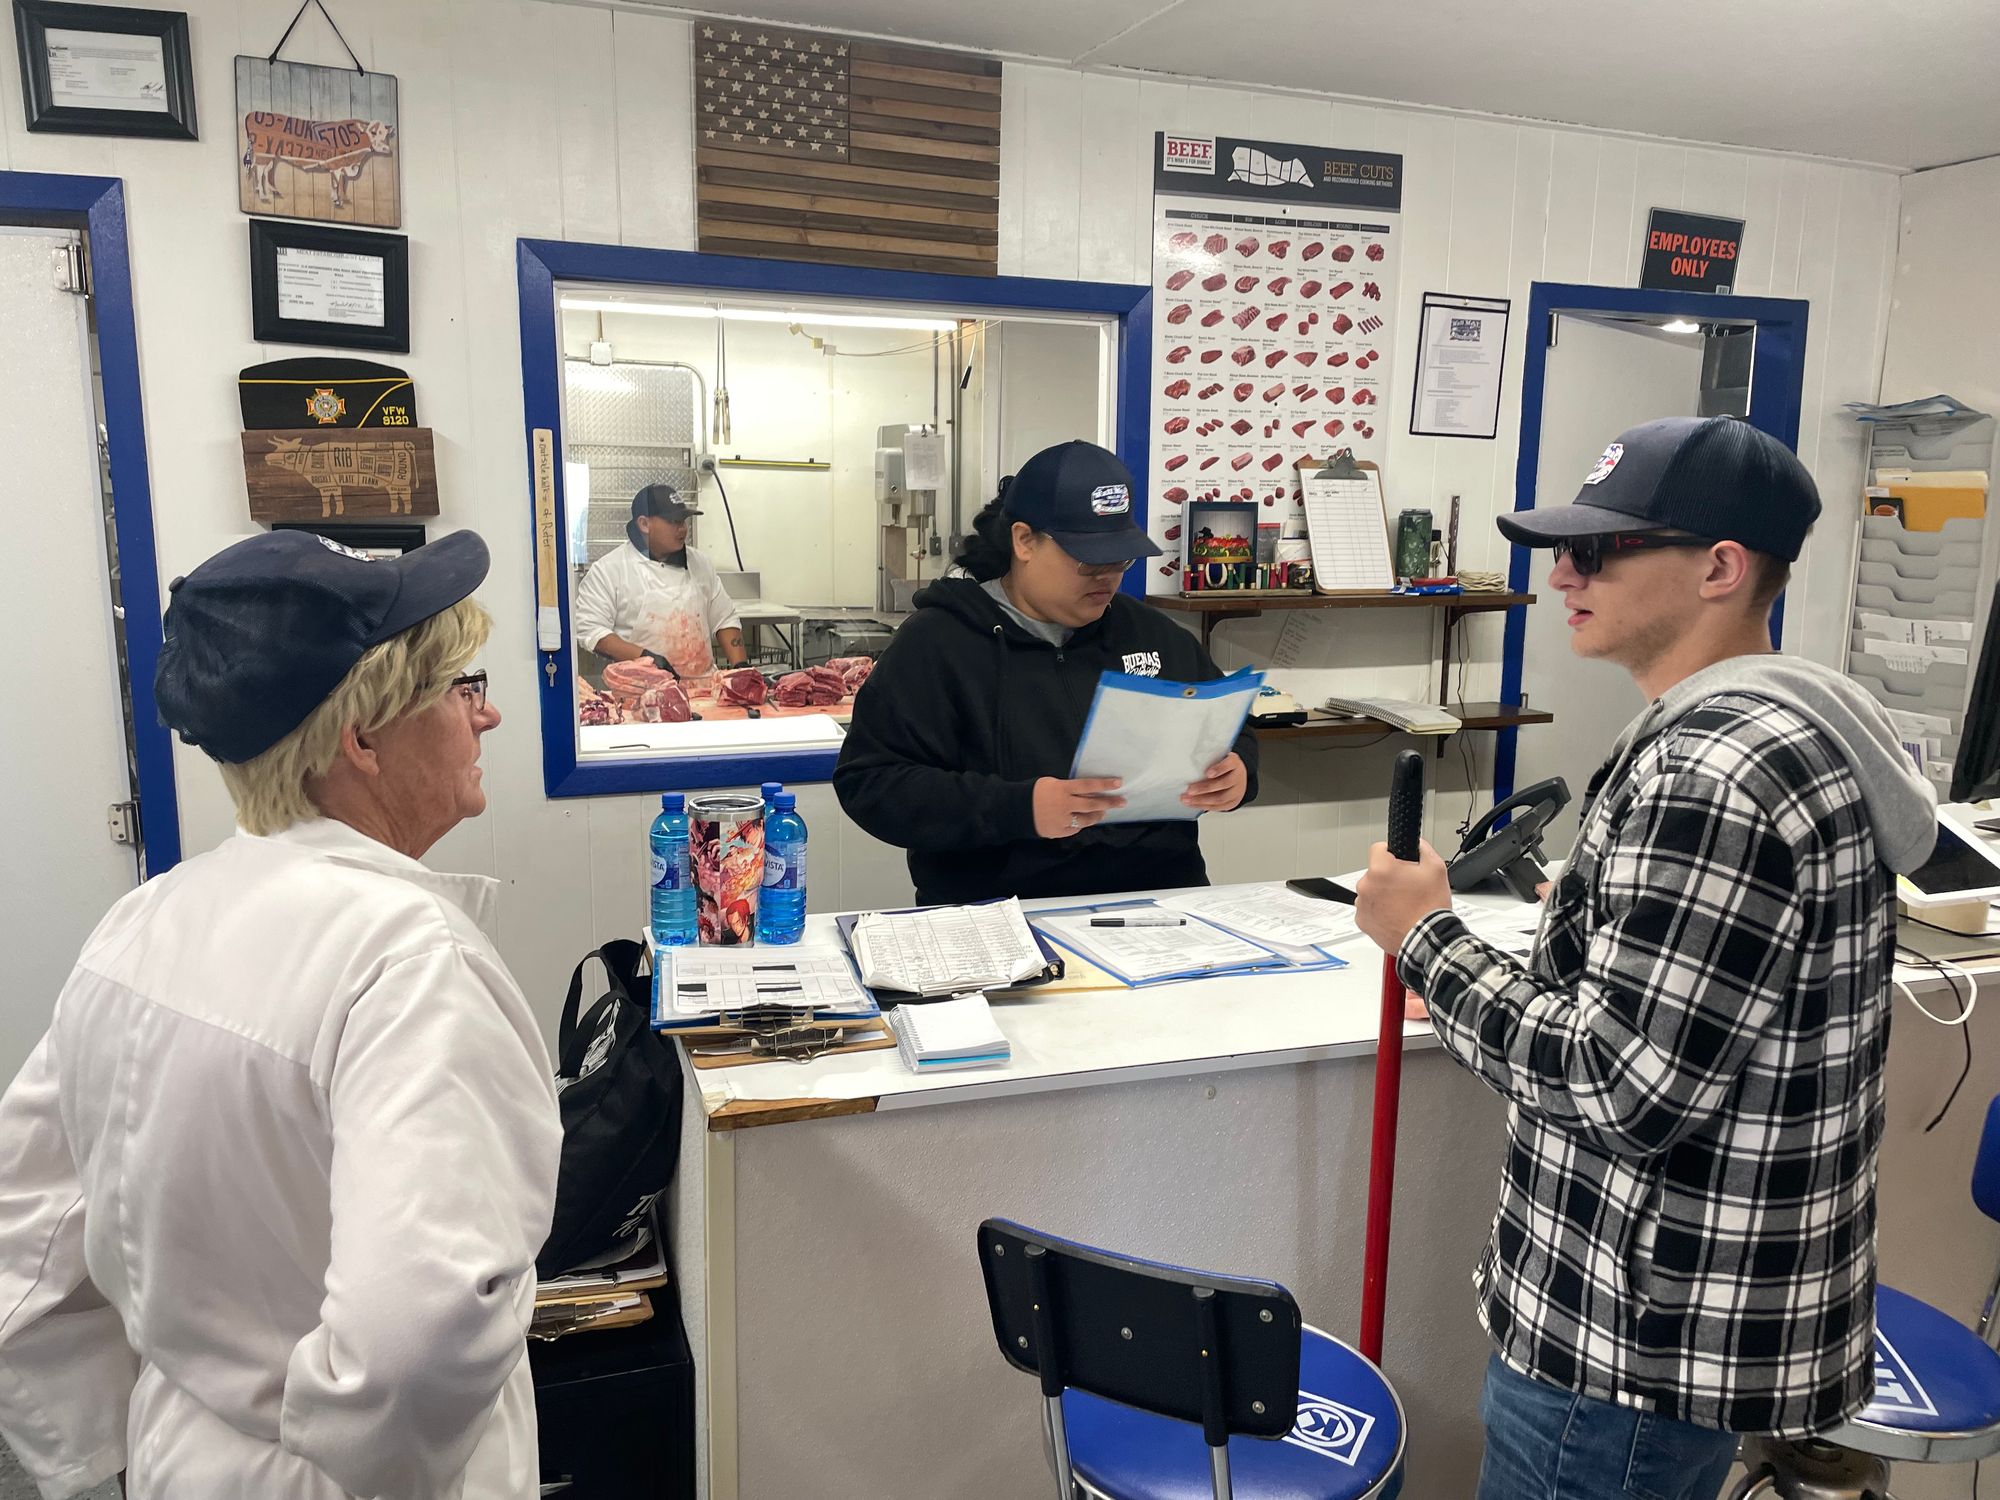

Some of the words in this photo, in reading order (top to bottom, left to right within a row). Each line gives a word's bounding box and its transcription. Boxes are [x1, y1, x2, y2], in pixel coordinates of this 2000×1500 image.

[1324, 161, 1358, 176] BEEF
[1360, 164, 1394, 180] CUTS
[1649, 231, 1736, 260] EMPLOYEES
[1671, 256, 1709, 279] ONLY
[382, 406, 405, 415] VFW
[334, 447, 352, 467] RIB
[397, 451, 407, 480] ROUND
[1122, 651, 1161, 674] BUENAS
